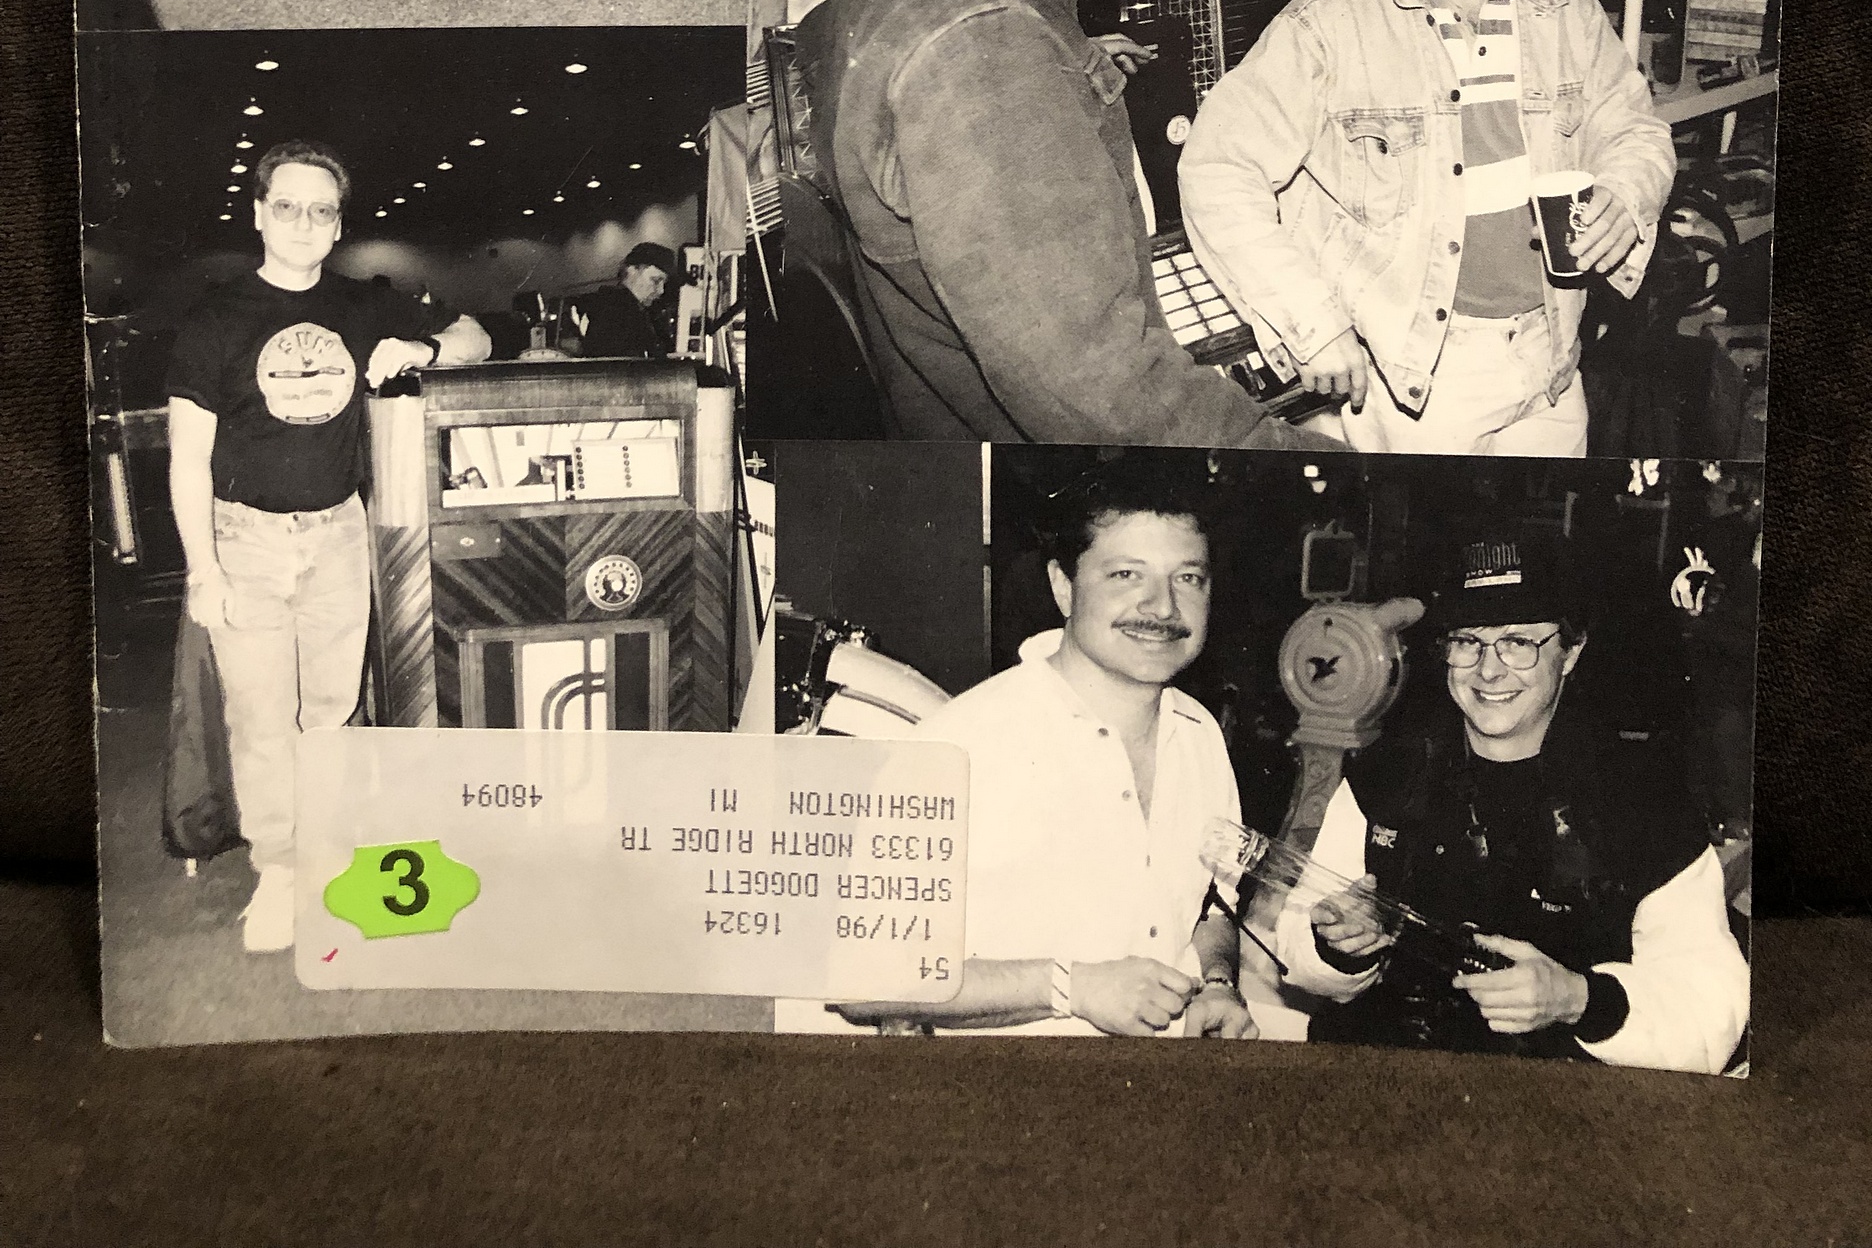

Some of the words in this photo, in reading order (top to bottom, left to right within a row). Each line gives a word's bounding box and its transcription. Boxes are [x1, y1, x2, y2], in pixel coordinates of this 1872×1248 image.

[461, 783, 544, 809] 48094
[710, 788, 738, 813] MI
[789, 791, 955, 821] WASHINGTON
[620, 825, 652, 852] TR
[671, 827, 753, 854] RIDGE
[771, 830, 853, 858] NORTH
[871, 834, 954, 862] 61333
[379, 849, 430, 917] 3
[704, 869, 819, 898] DOGGETT
[837, 873, 952, 903] SPENCER
[704, 910, 782, 936] 16324
[836, 914, 932, 942] 1/1/98
[918, 956, 950, 981] 54
